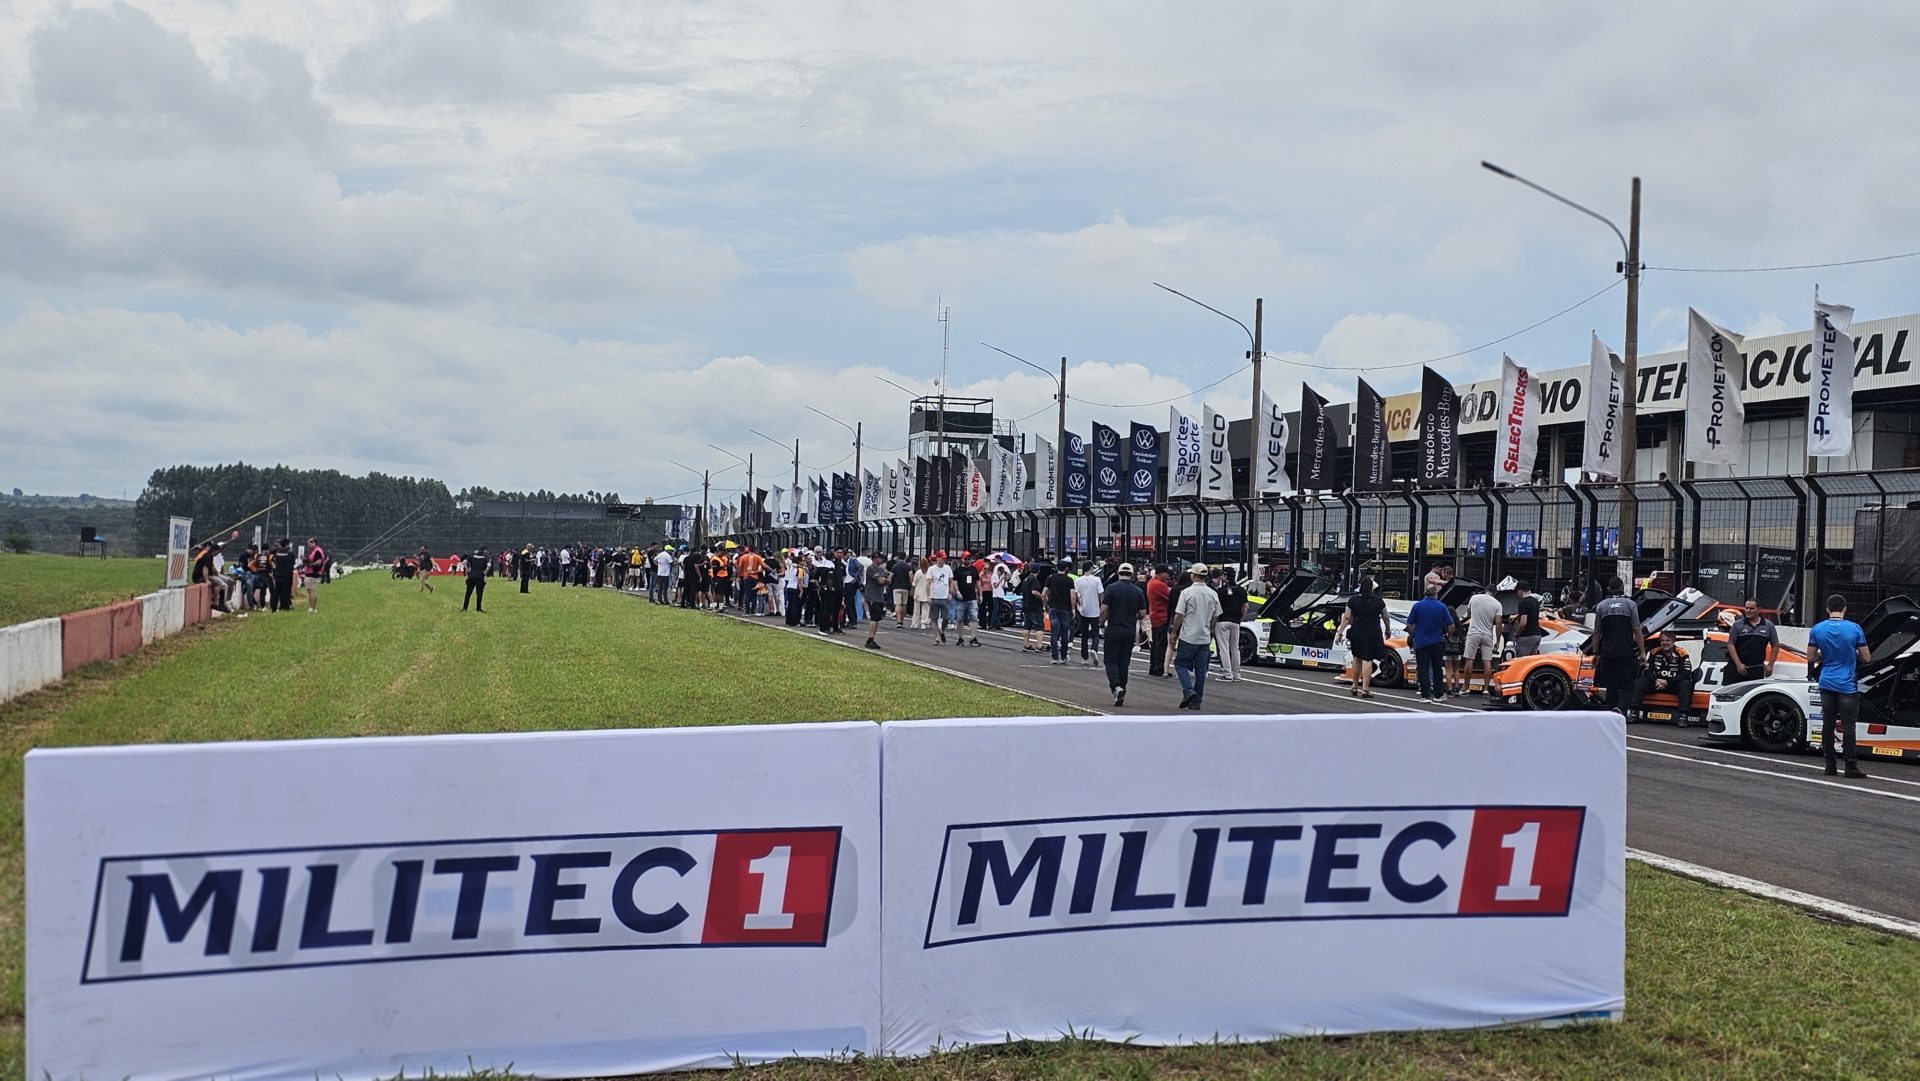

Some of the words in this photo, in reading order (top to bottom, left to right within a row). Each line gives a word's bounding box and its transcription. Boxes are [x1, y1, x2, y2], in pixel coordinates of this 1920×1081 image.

[1209, 413, 1225, 491] IVECO
[1425, 413, 1435, 480] CONSÓRCIO
[1436, 386, 1452, 479] Mercedes-Ben
[889, 468, 898, 514] IVECO
[1301, 648, 1329, 659] Mobil
[119, 845, 698, 962] MILITEC
[742, 845, 796, 931] 1
[956, 820, 1458, 926] MILITEC
[1494, 821, 1542, 902] 1
